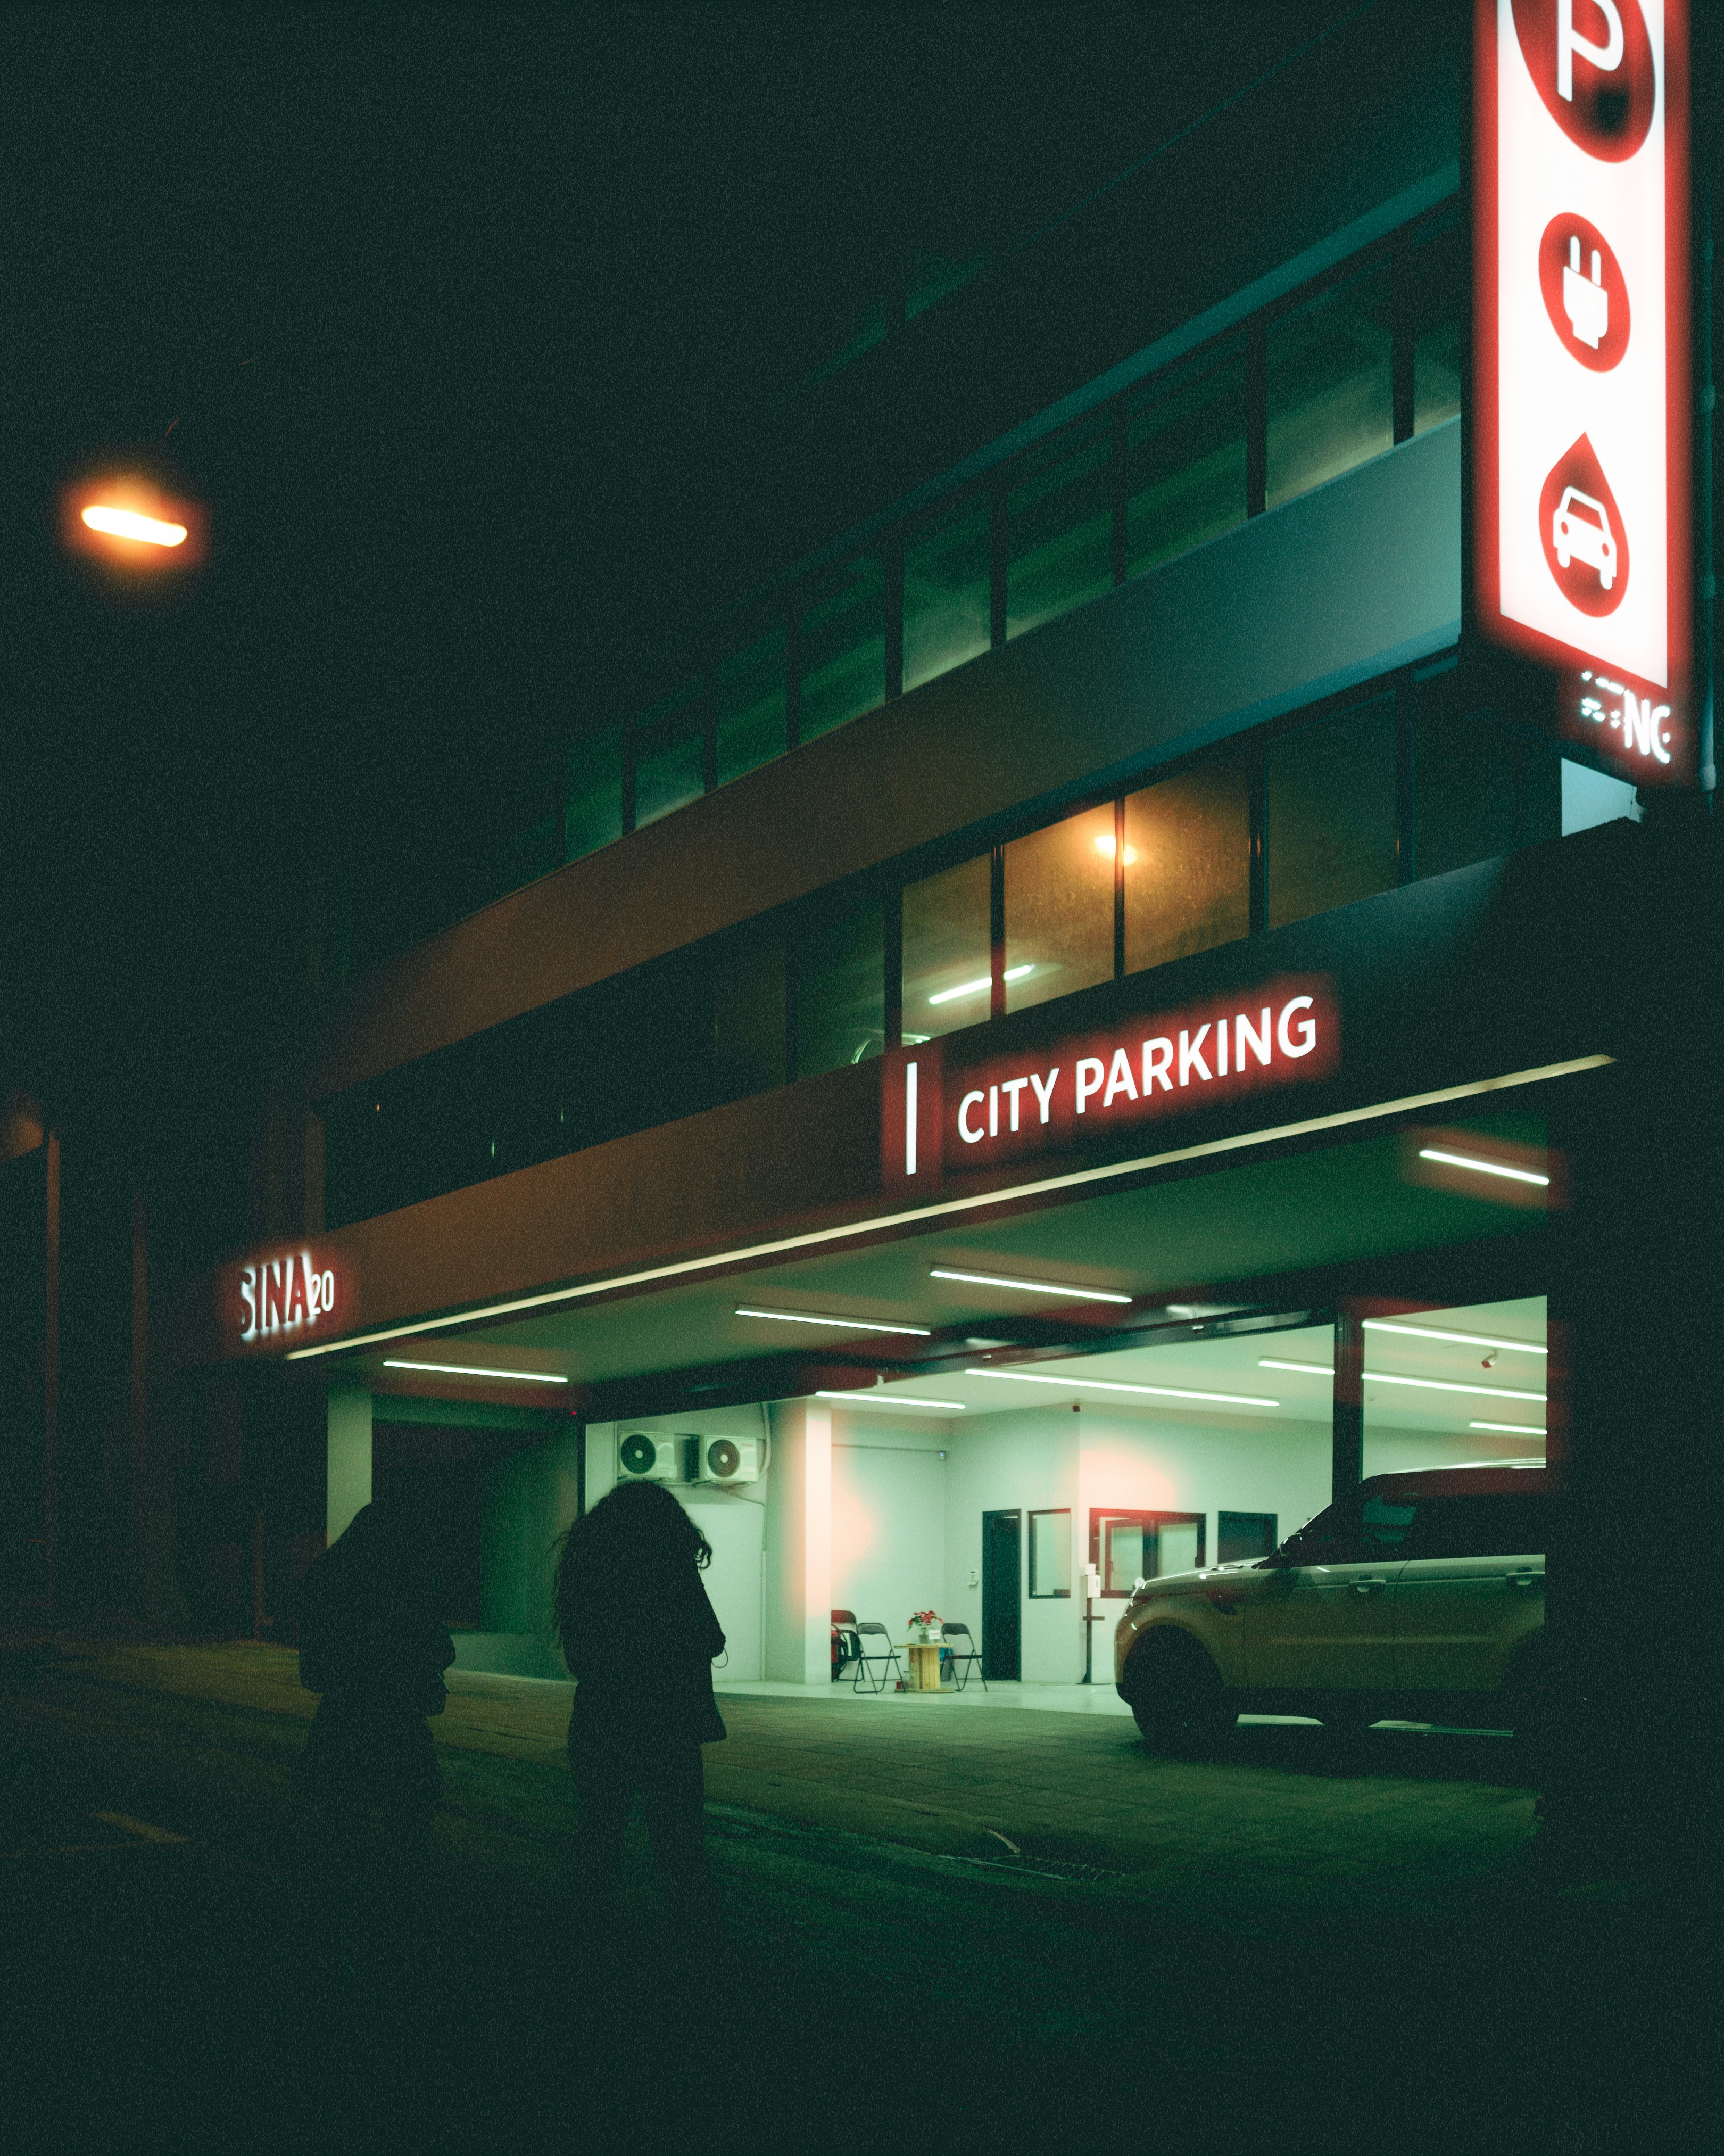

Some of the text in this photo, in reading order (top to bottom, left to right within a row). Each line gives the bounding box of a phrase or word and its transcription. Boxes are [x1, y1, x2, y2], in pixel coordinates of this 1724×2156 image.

[1557, 0, 1624, 102] P
[958, 996, 1316, 1143] CITY PARKING
[238, 1254, 334, 1336] SINA 20
